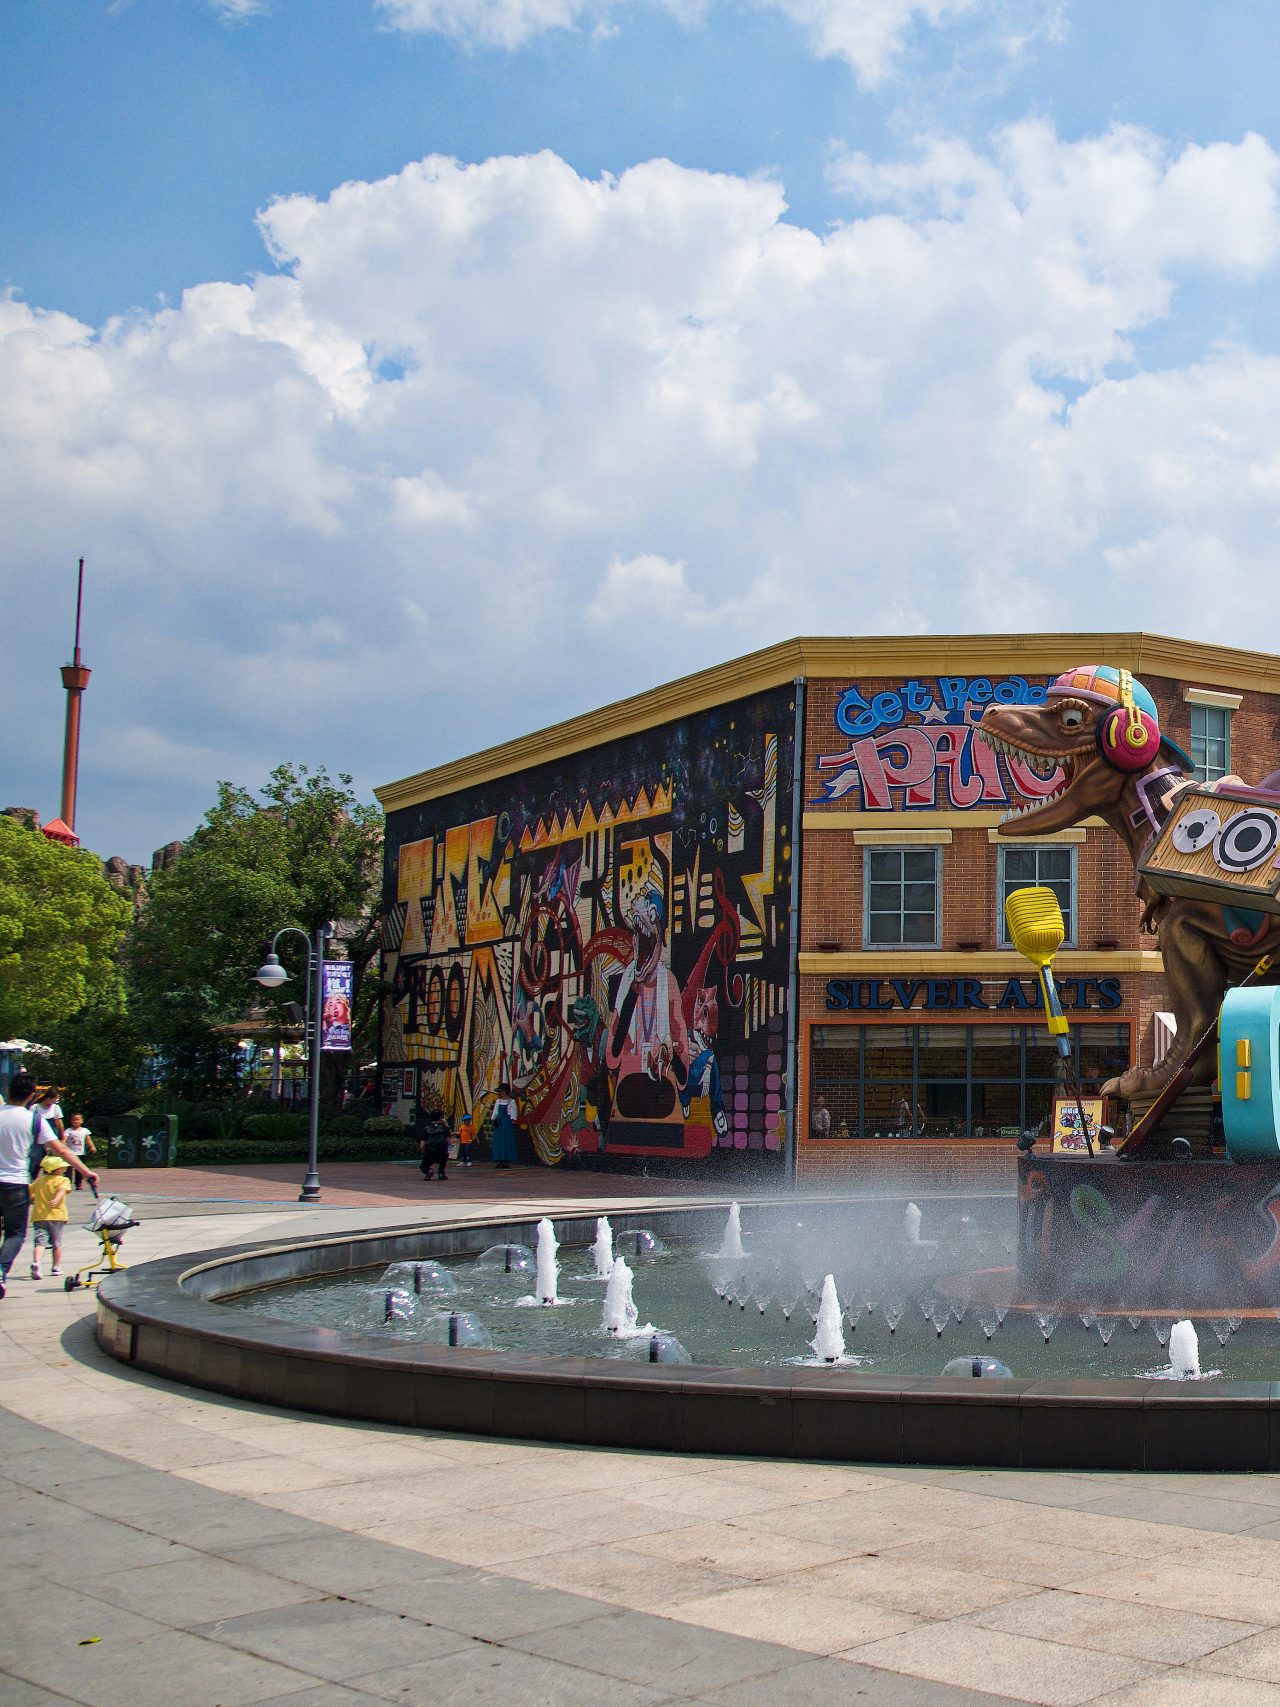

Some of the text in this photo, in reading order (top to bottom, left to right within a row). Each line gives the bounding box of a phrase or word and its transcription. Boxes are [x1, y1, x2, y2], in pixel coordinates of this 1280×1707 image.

[836, 676, 1055, 736] Get Read
[826, 977, 1123, 1010] SILVER ARTS
